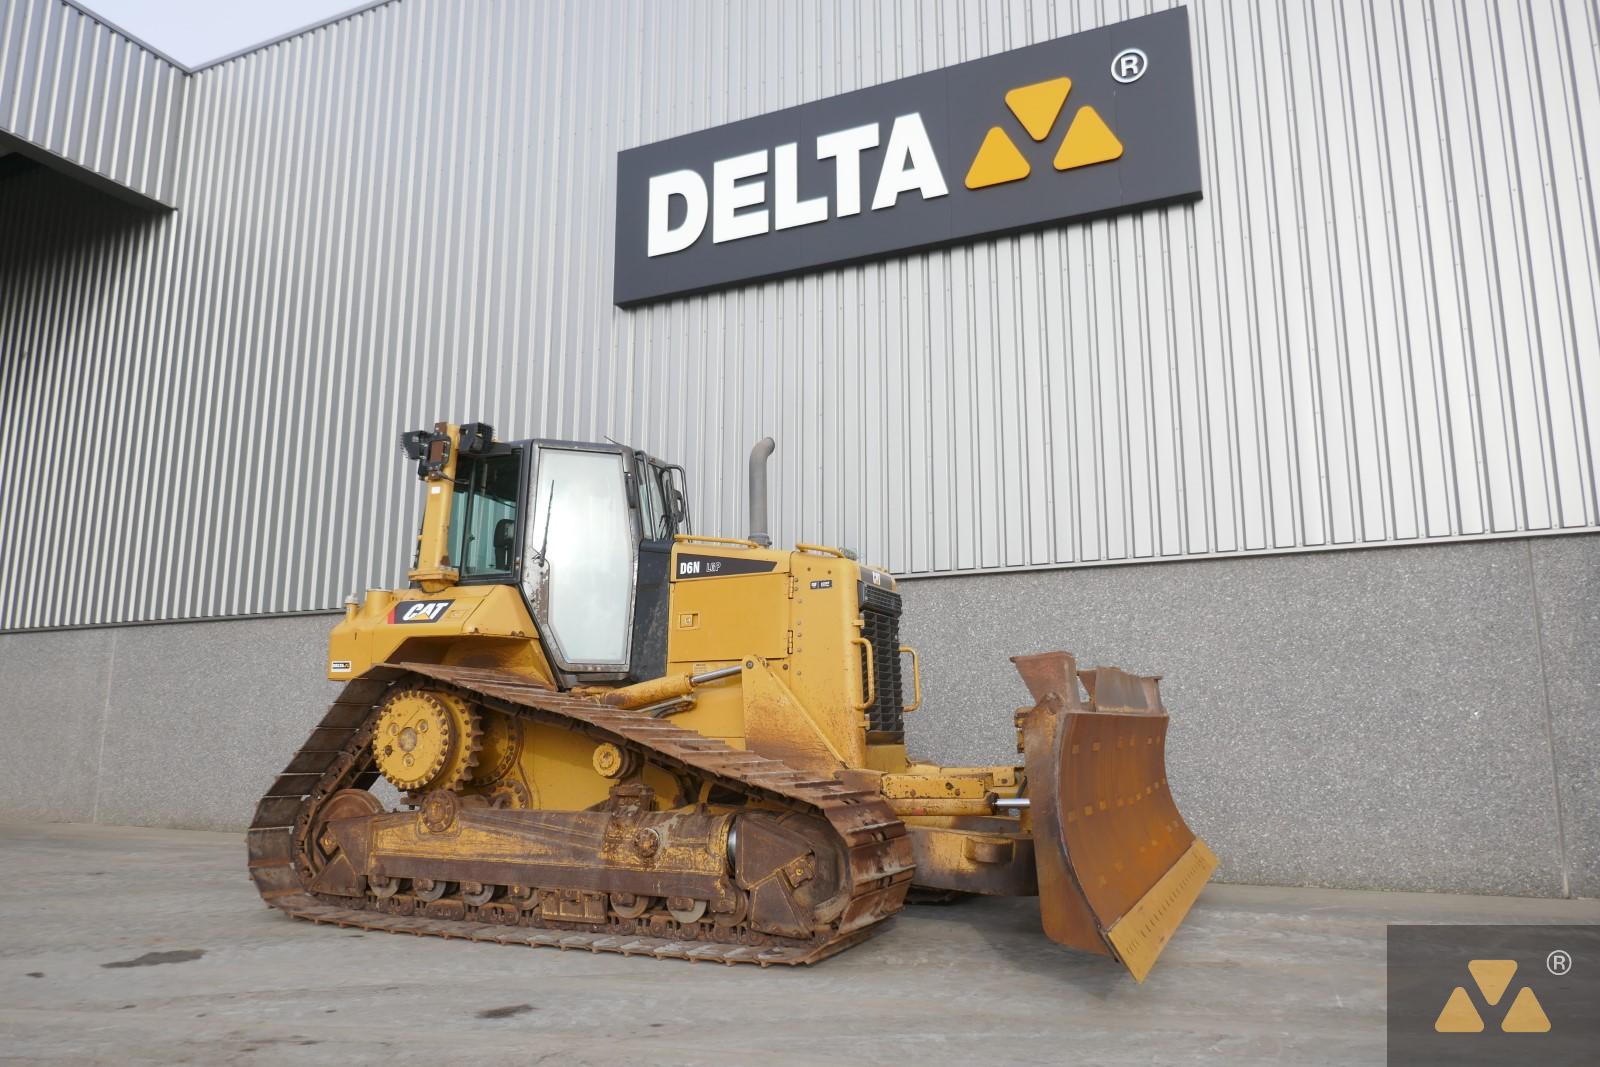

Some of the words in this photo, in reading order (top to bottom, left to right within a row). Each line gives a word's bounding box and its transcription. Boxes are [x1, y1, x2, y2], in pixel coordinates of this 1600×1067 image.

[648, 112, 949, 257] DELTA
[680, 561, 700, 575] D6N
[402, 602, 449, 621] CAT
